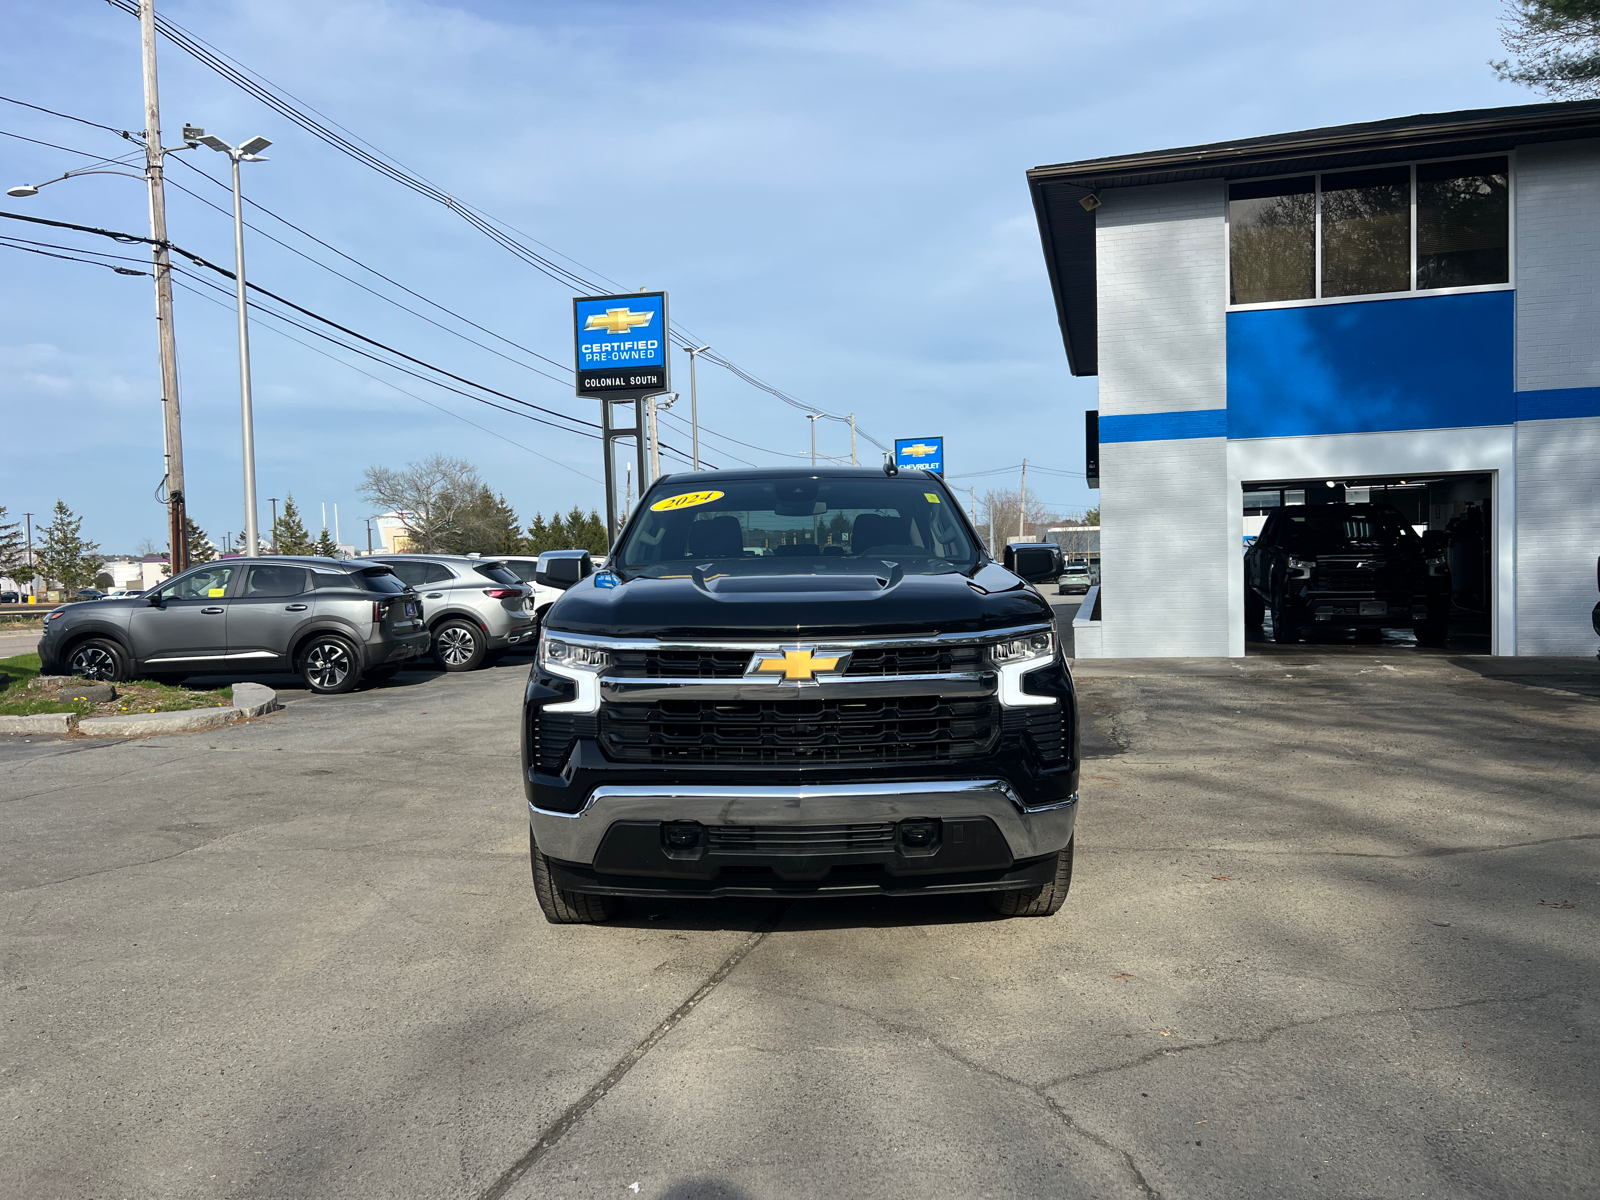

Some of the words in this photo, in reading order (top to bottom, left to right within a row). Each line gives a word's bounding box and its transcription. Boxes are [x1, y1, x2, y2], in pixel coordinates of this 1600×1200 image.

[582, 340, 658, 353] CERTIFIED
[586, 350, 655, 362] PRE-OWNED
[585, 378, 626, 387] COLONIAL
[630, 375, 657, 385] SOUTH
[663, 491, 714, 509] 2024
